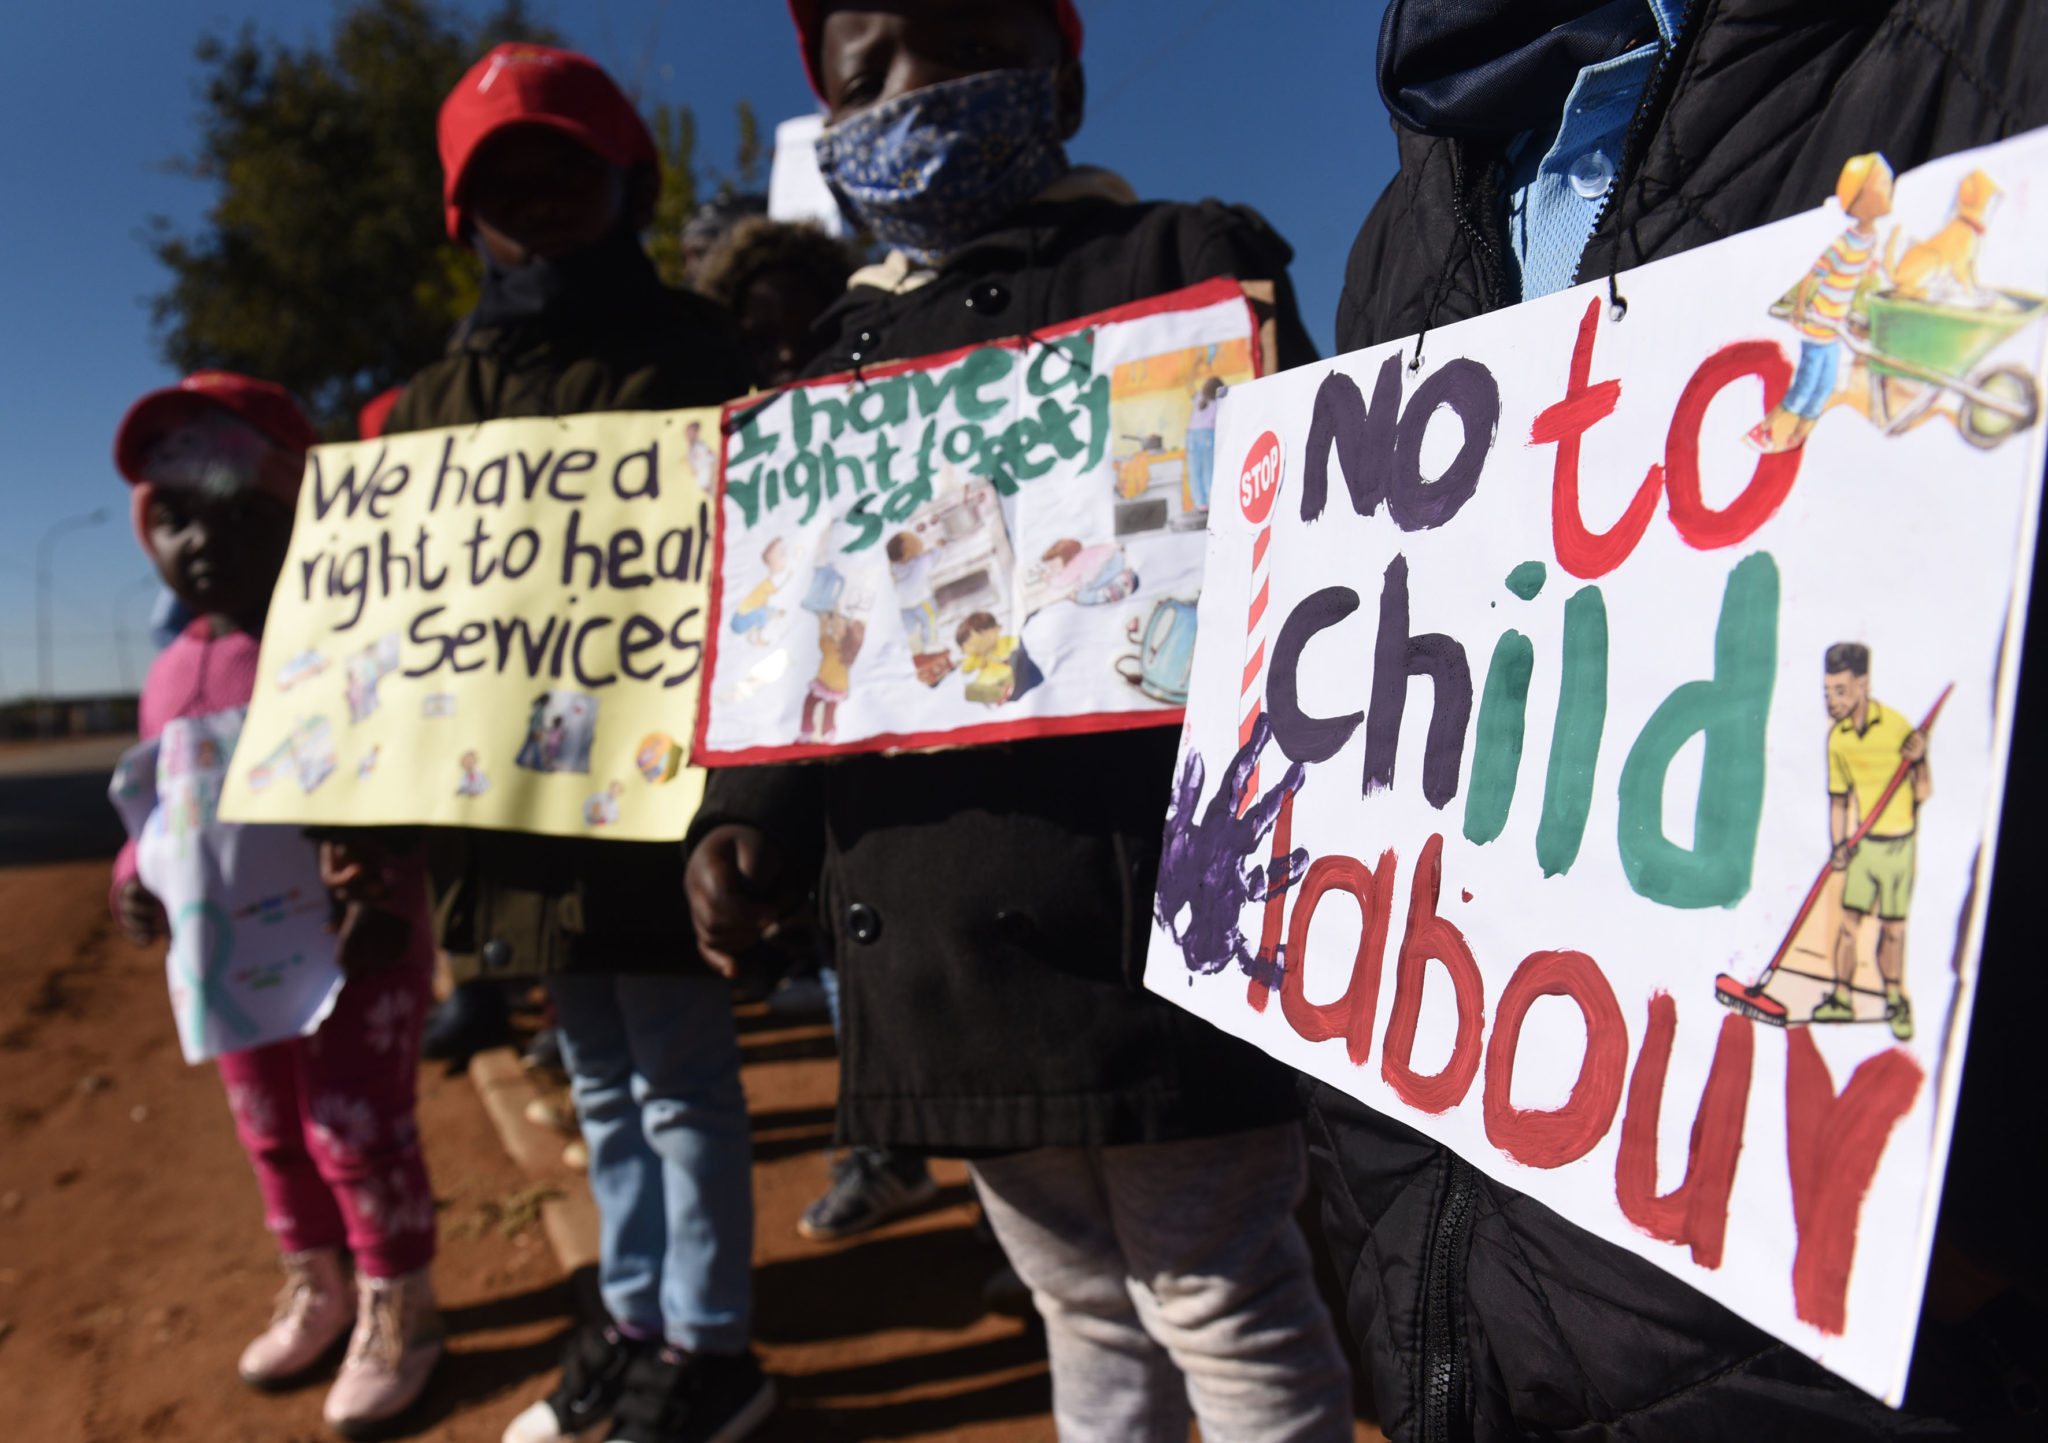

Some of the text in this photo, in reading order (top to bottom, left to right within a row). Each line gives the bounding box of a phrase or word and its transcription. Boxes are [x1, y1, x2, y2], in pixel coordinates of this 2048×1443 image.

[728, 327, 1095, 468] I have a
[840, 374, 1111, 553] safety
[1530, 296, 1804, 579] to
[311, 436, 659, 520] We have a
[725, 419, 984, 531] right to
[1242, 445, 1279, 507] STOP
[301, 502, 709, 631] right to heal
[1247, 788, 1924, 1336] labour
